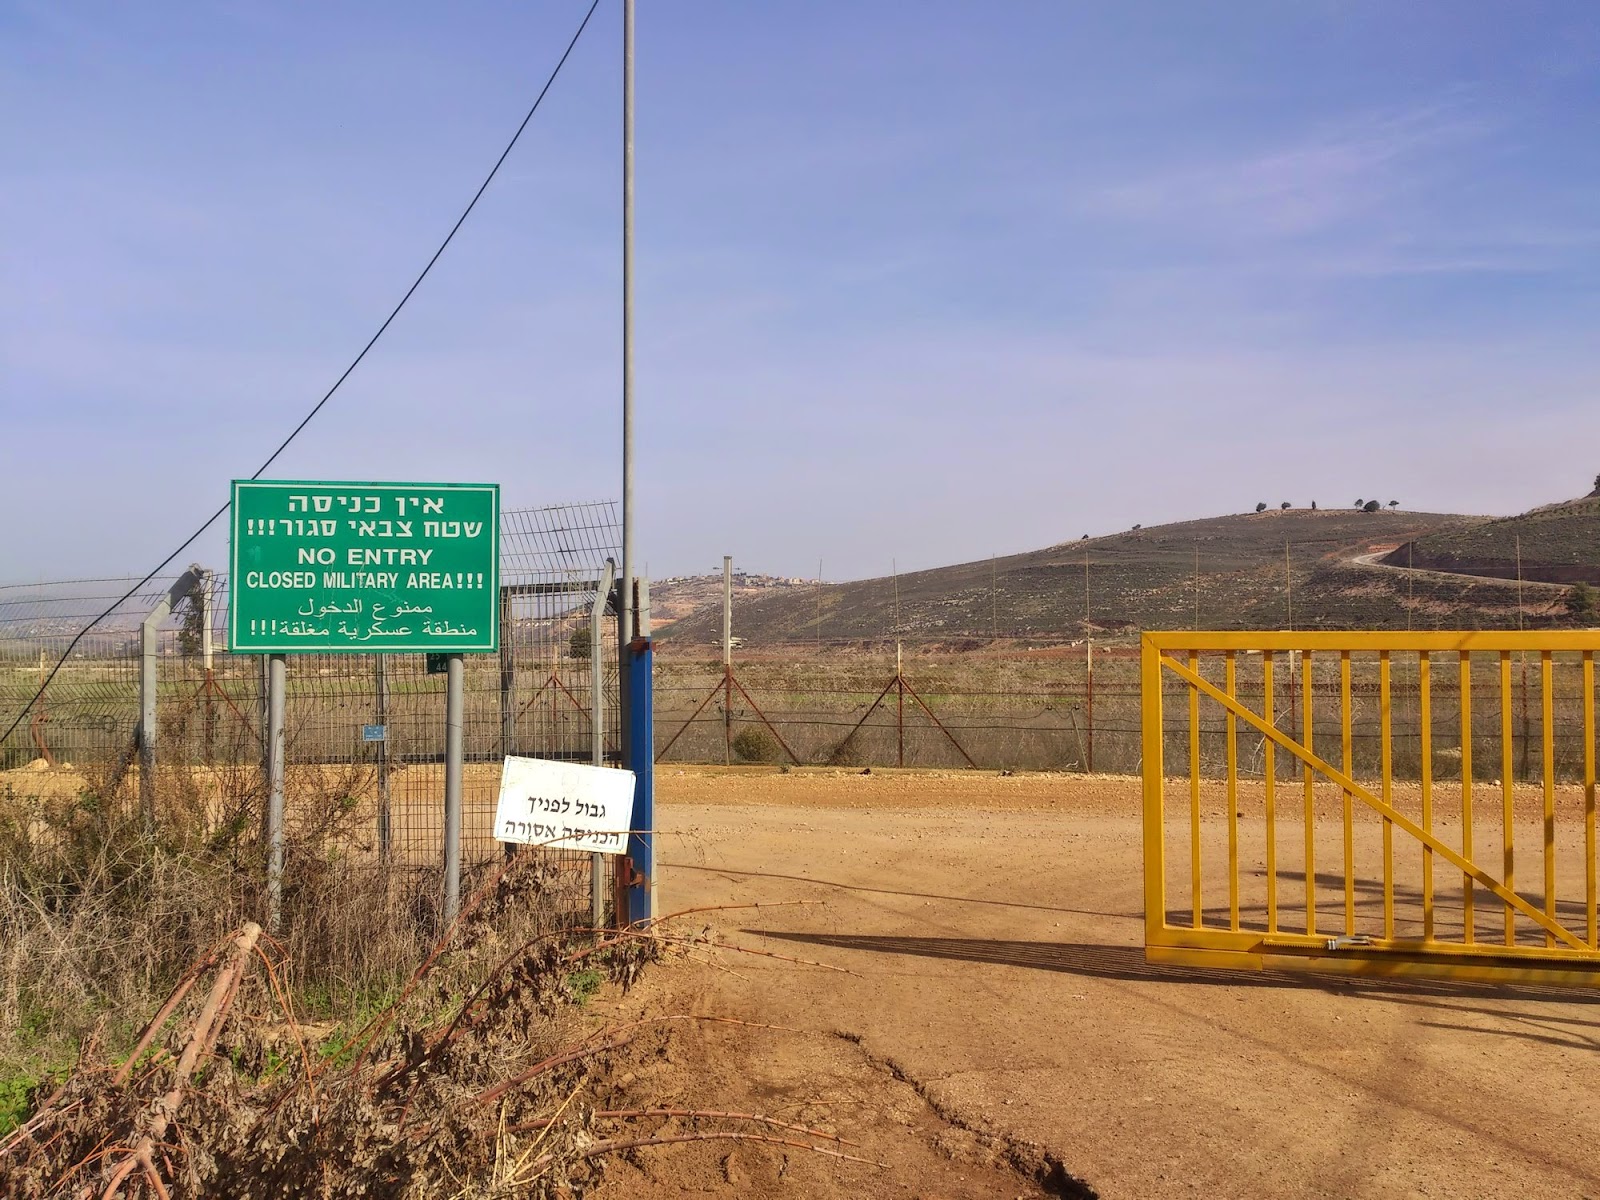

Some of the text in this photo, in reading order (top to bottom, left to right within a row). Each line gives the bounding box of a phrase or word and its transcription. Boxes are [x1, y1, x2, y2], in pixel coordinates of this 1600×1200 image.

[289, 496, 443, 516] אין כניסה
[348, 521, 412, 537] צבאי
[424, 522, 482, 537] שטח
[299, 548, 432, 566] NO ENTRY
[247, 572, 482, 588] CLOSED MILITARY AREA!!!
[299, 599, 432, 620] ممنوع الدخول
[338, 621, 412, 640] عسكرية
[423, 621, 476, 635] منطقة
[528, 797, 605, 818] גבול לפניך
[506, 821, 620, 845] הכניסה אסורה
